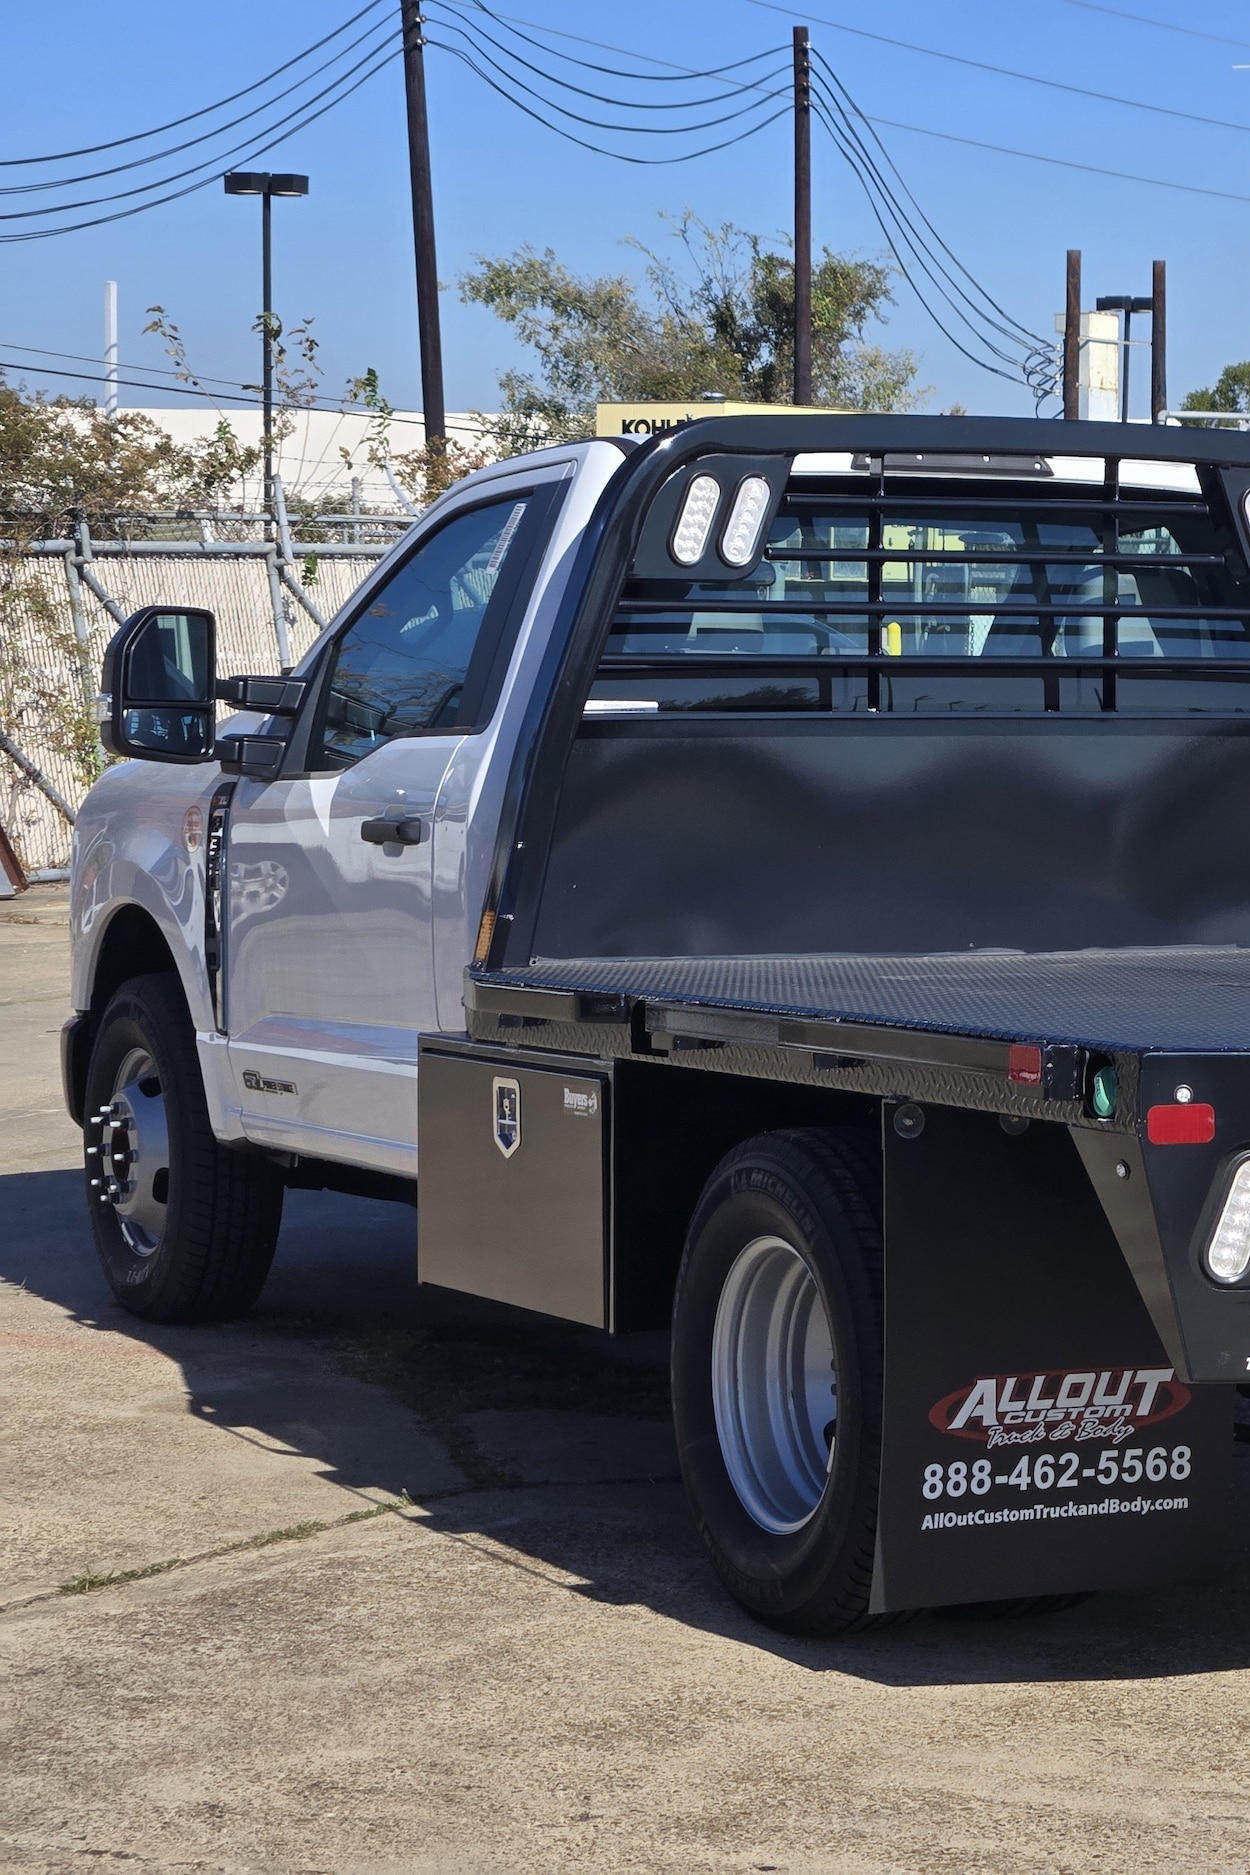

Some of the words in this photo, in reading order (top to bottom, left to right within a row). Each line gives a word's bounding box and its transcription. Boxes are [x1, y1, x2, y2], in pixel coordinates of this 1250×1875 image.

[946, 1367, 1176, 1430] ALLOUT
[1003, 1403, 1134, 1425] CUSTOM
[986, 1421, 1046, 1449] Truck
[1049, 1422, 1076, 1442] &
[1074, 1416, 1136, 1444] Body
[921, 1445, 1192, 1500] 888-462-5568
[920, 1496, 1189, 1531] AllOutCustomTruckandBody.com
